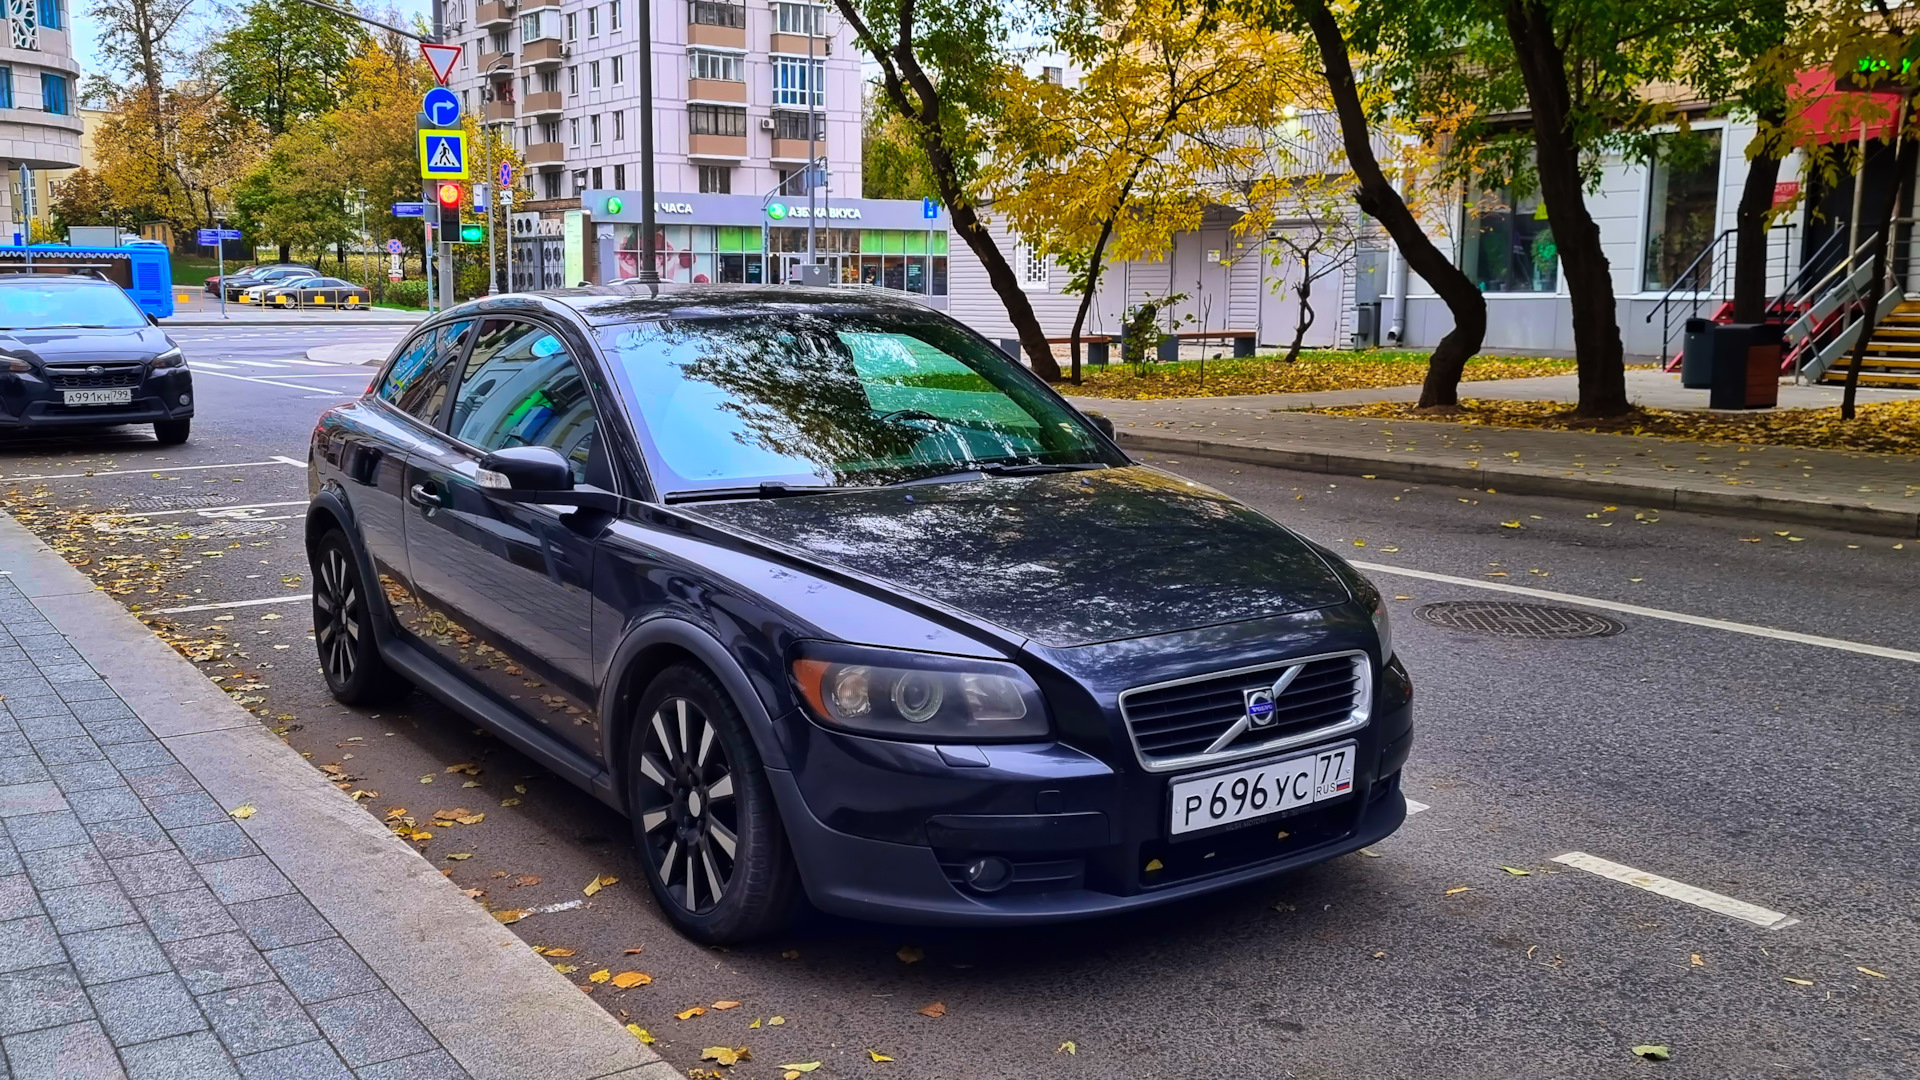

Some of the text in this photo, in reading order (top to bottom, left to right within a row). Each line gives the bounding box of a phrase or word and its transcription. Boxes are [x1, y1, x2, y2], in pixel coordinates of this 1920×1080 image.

[661, 202, 693, 214] ЧАСА
[788, 206, 862, 220] АЗБКА ВКУСА
[112, 390, 128, 398] 799
[1320, 751, 1346, 785] 77
[1316, 782, 1336, 797] RUS
